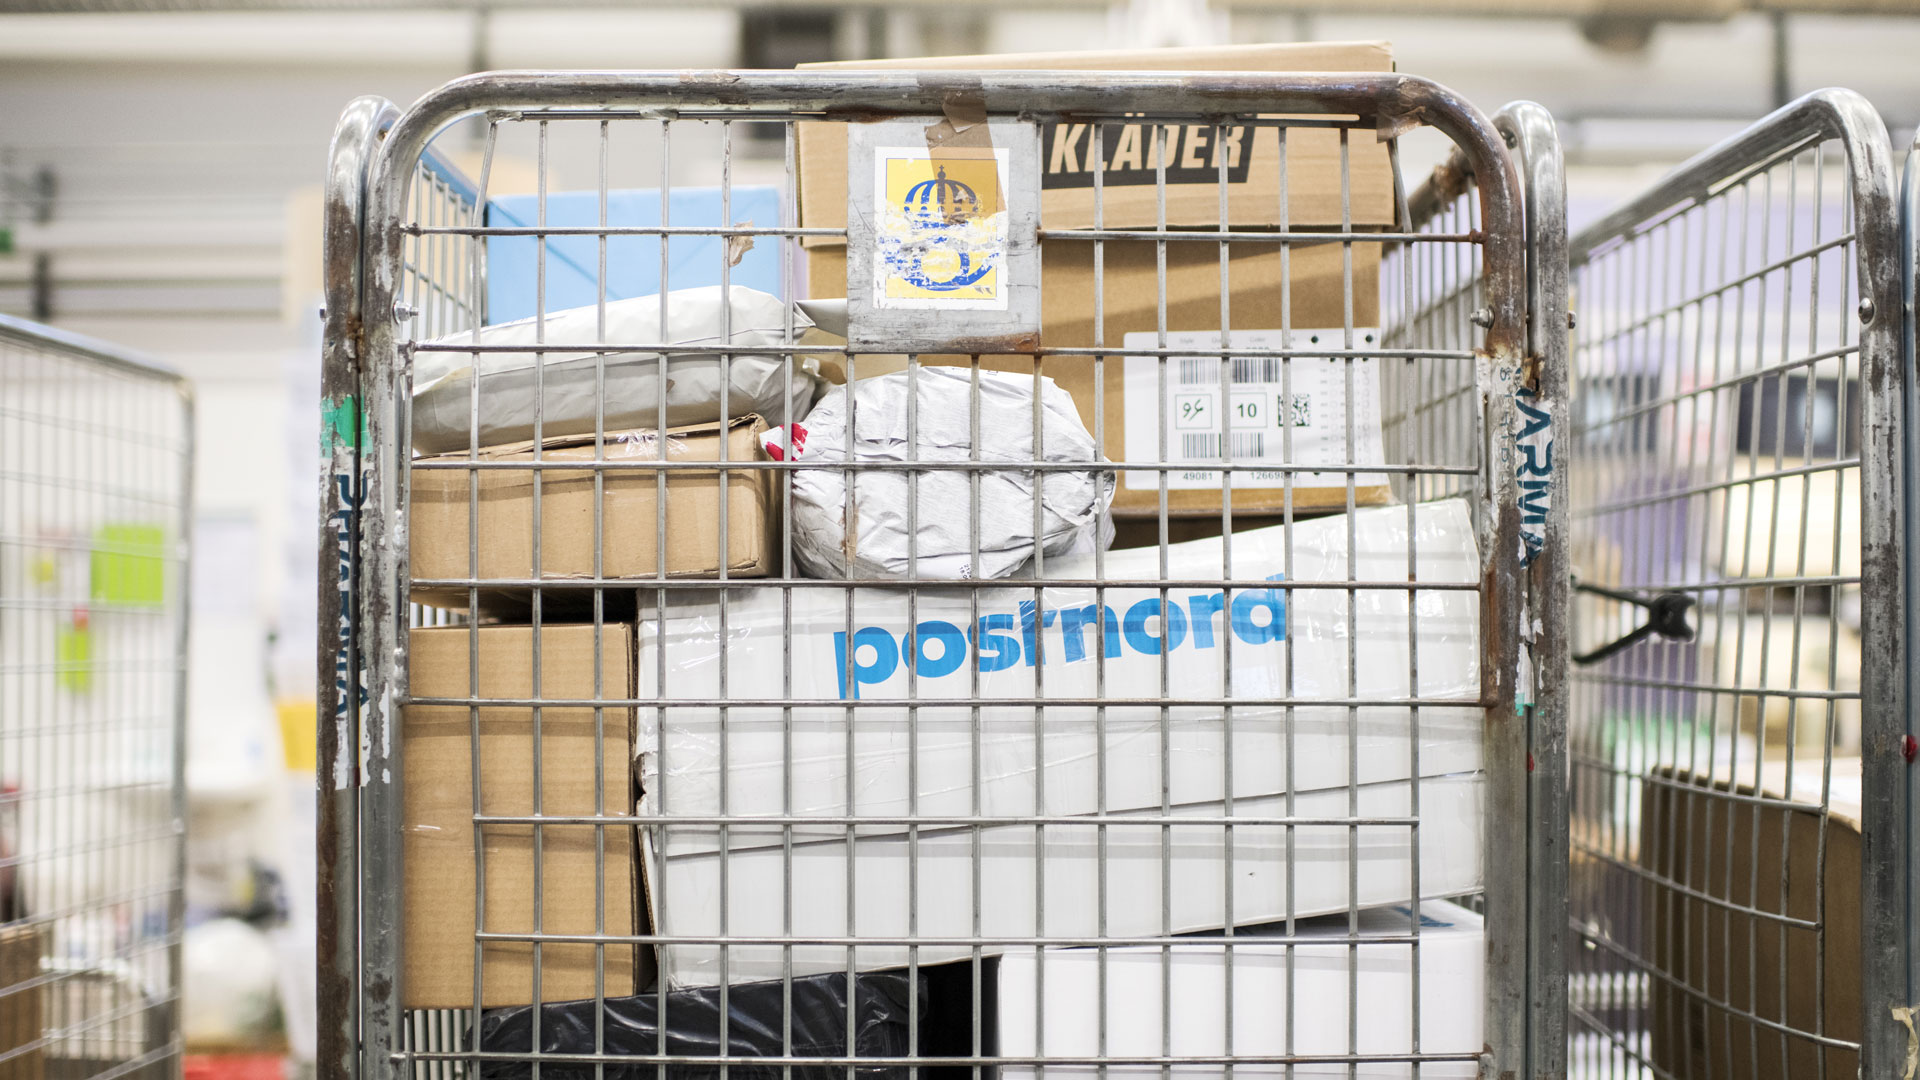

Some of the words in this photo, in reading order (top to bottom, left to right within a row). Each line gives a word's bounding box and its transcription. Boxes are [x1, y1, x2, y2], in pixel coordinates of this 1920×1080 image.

[1049, 112, 1245, 174] KLÄDER
[1236, 402, 1257, 418] 10
[1183, 471, 1213, 481] 49081
[1250, 471, 1299, 481] 1266987
[1514, 367, 1554, 570] ARMA
[331, 470, 370, 714] PHA
[833, 573, 1286, 701] postnord
